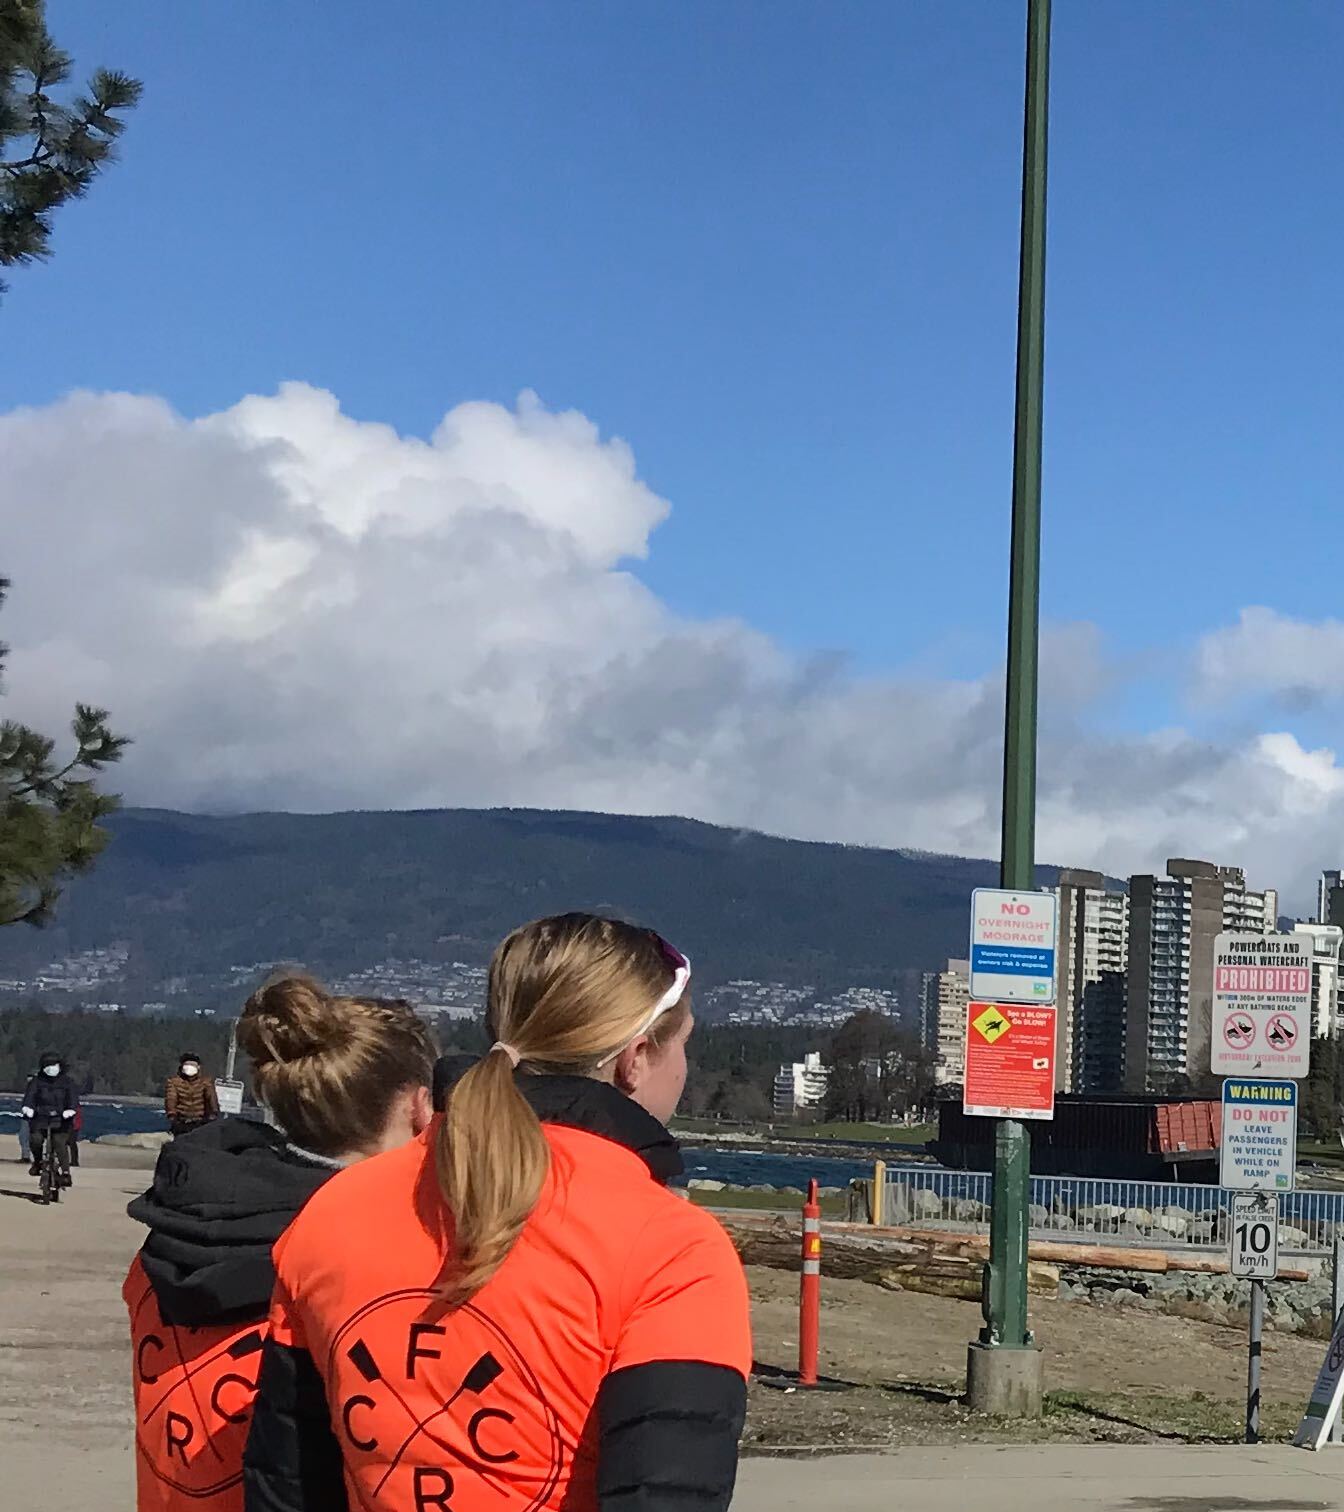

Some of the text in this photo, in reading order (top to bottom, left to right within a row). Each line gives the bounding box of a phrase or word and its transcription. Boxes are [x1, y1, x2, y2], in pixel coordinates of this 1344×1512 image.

[1001, 904, 1030, 915] NO
[978, 918, 1050, 930] OVERNIGHT
[983, 932, 1044, 942] MOORAGE
[1230, 942, 1299, 953] POWERBOATS AND
[1218, 955, 1308, 967] PERSONAL WATERCRAFT
[1220, 969, 1306, 991] PROHIBITED
[1230, 1085, 1292, 1100] WARNING
[1232, 1109, 1288, 1122] DO NOT
[1244, 1125, 1272, 1134] LEAVE
[1229, 1135, 1287, 1145] PASSENGERS
[1245, 1147, 1282, 1156] VEHICLE
[1235, 1158, 1279, 1167] WHILE ON
[1243, 1169, 1270, 1177] RAMP
[1236, 1223, 1270, 1253] 10
[1240, 1253, 1268, 1267] km/h
